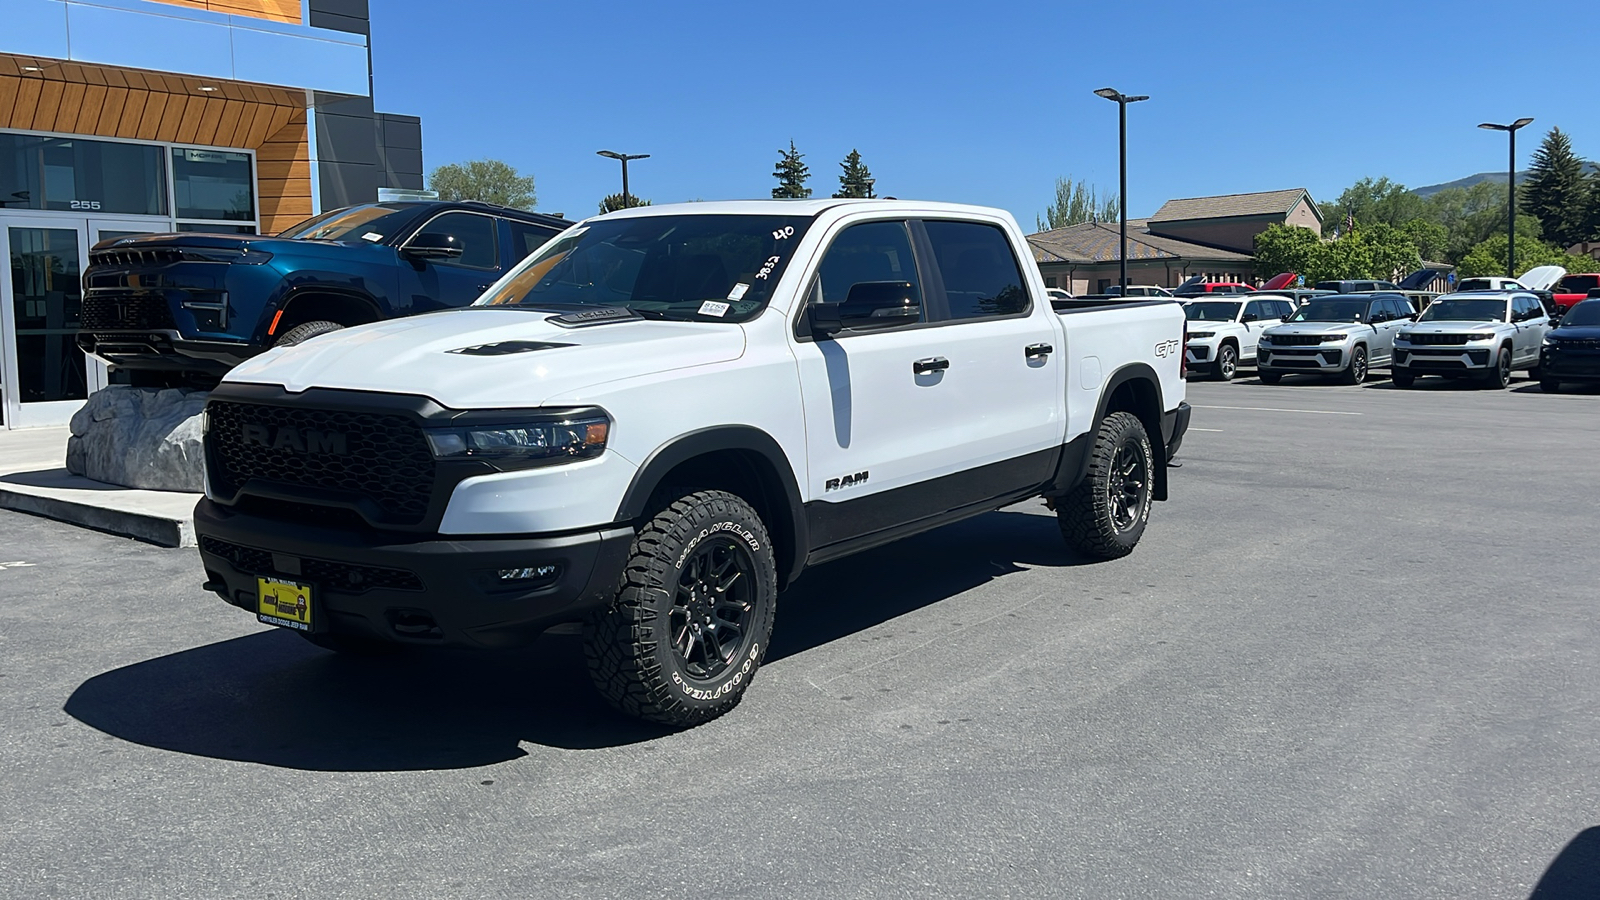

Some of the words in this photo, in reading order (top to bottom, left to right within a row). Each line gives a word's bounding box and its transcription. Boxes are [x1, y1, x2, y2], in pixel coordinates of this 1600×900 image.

[70, 200, 101, 210] 255
[772, 226, 795, 240] 40
[755, 255, 780, 280] 3832
[704, 302, 727, 310] 8755
[242, 423, 347, 455] RAM
[825, 470, 869, 490] RAM
[676, 521, 760, 570] WRANGLER
[260, 615, 278, 623] CHRYSLER
[278, 618, 291, 627] DODGE
[672, 643, 759, 700] GOODYEAR
